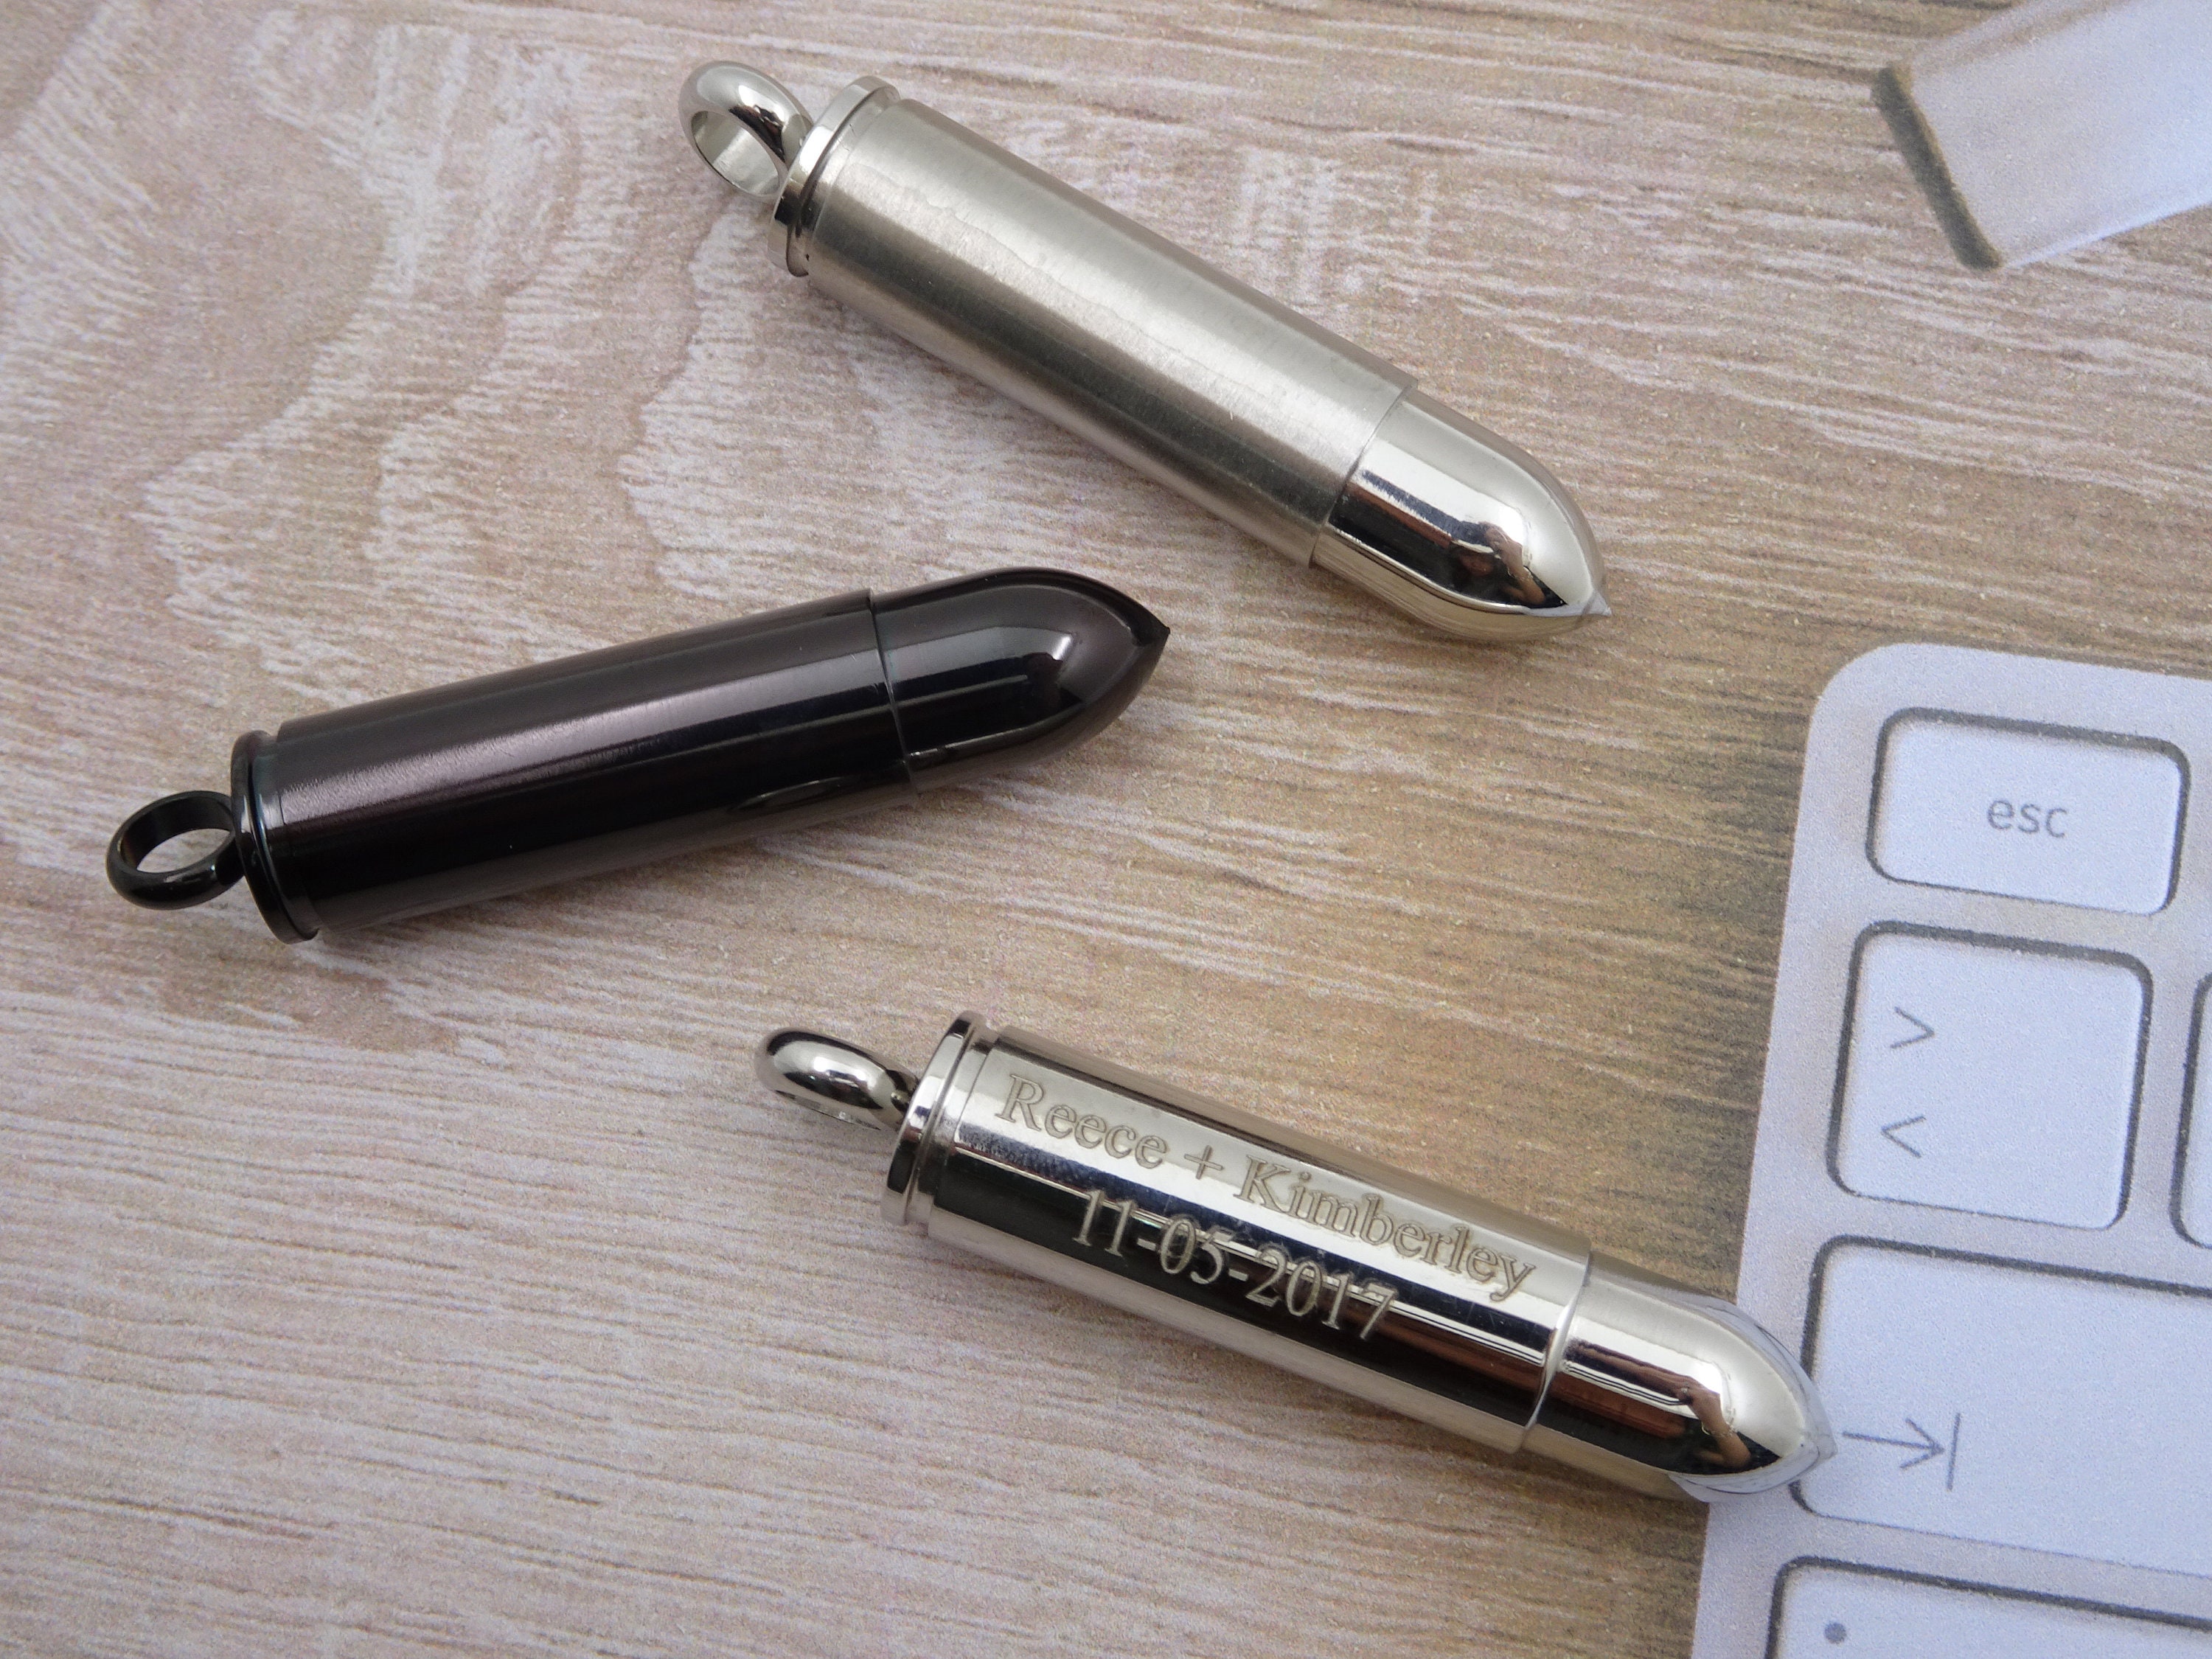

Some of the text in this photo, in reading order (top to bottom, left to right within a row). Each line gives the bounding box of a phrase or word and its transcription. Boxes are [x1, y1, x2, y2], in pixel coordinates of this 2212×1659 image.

[1986, 796, 2068, 838] esc
[995, 1074, 1537, 1303] Reece + Kimberley
[1072, 1189, 1397, 1340] 11-05-2017
